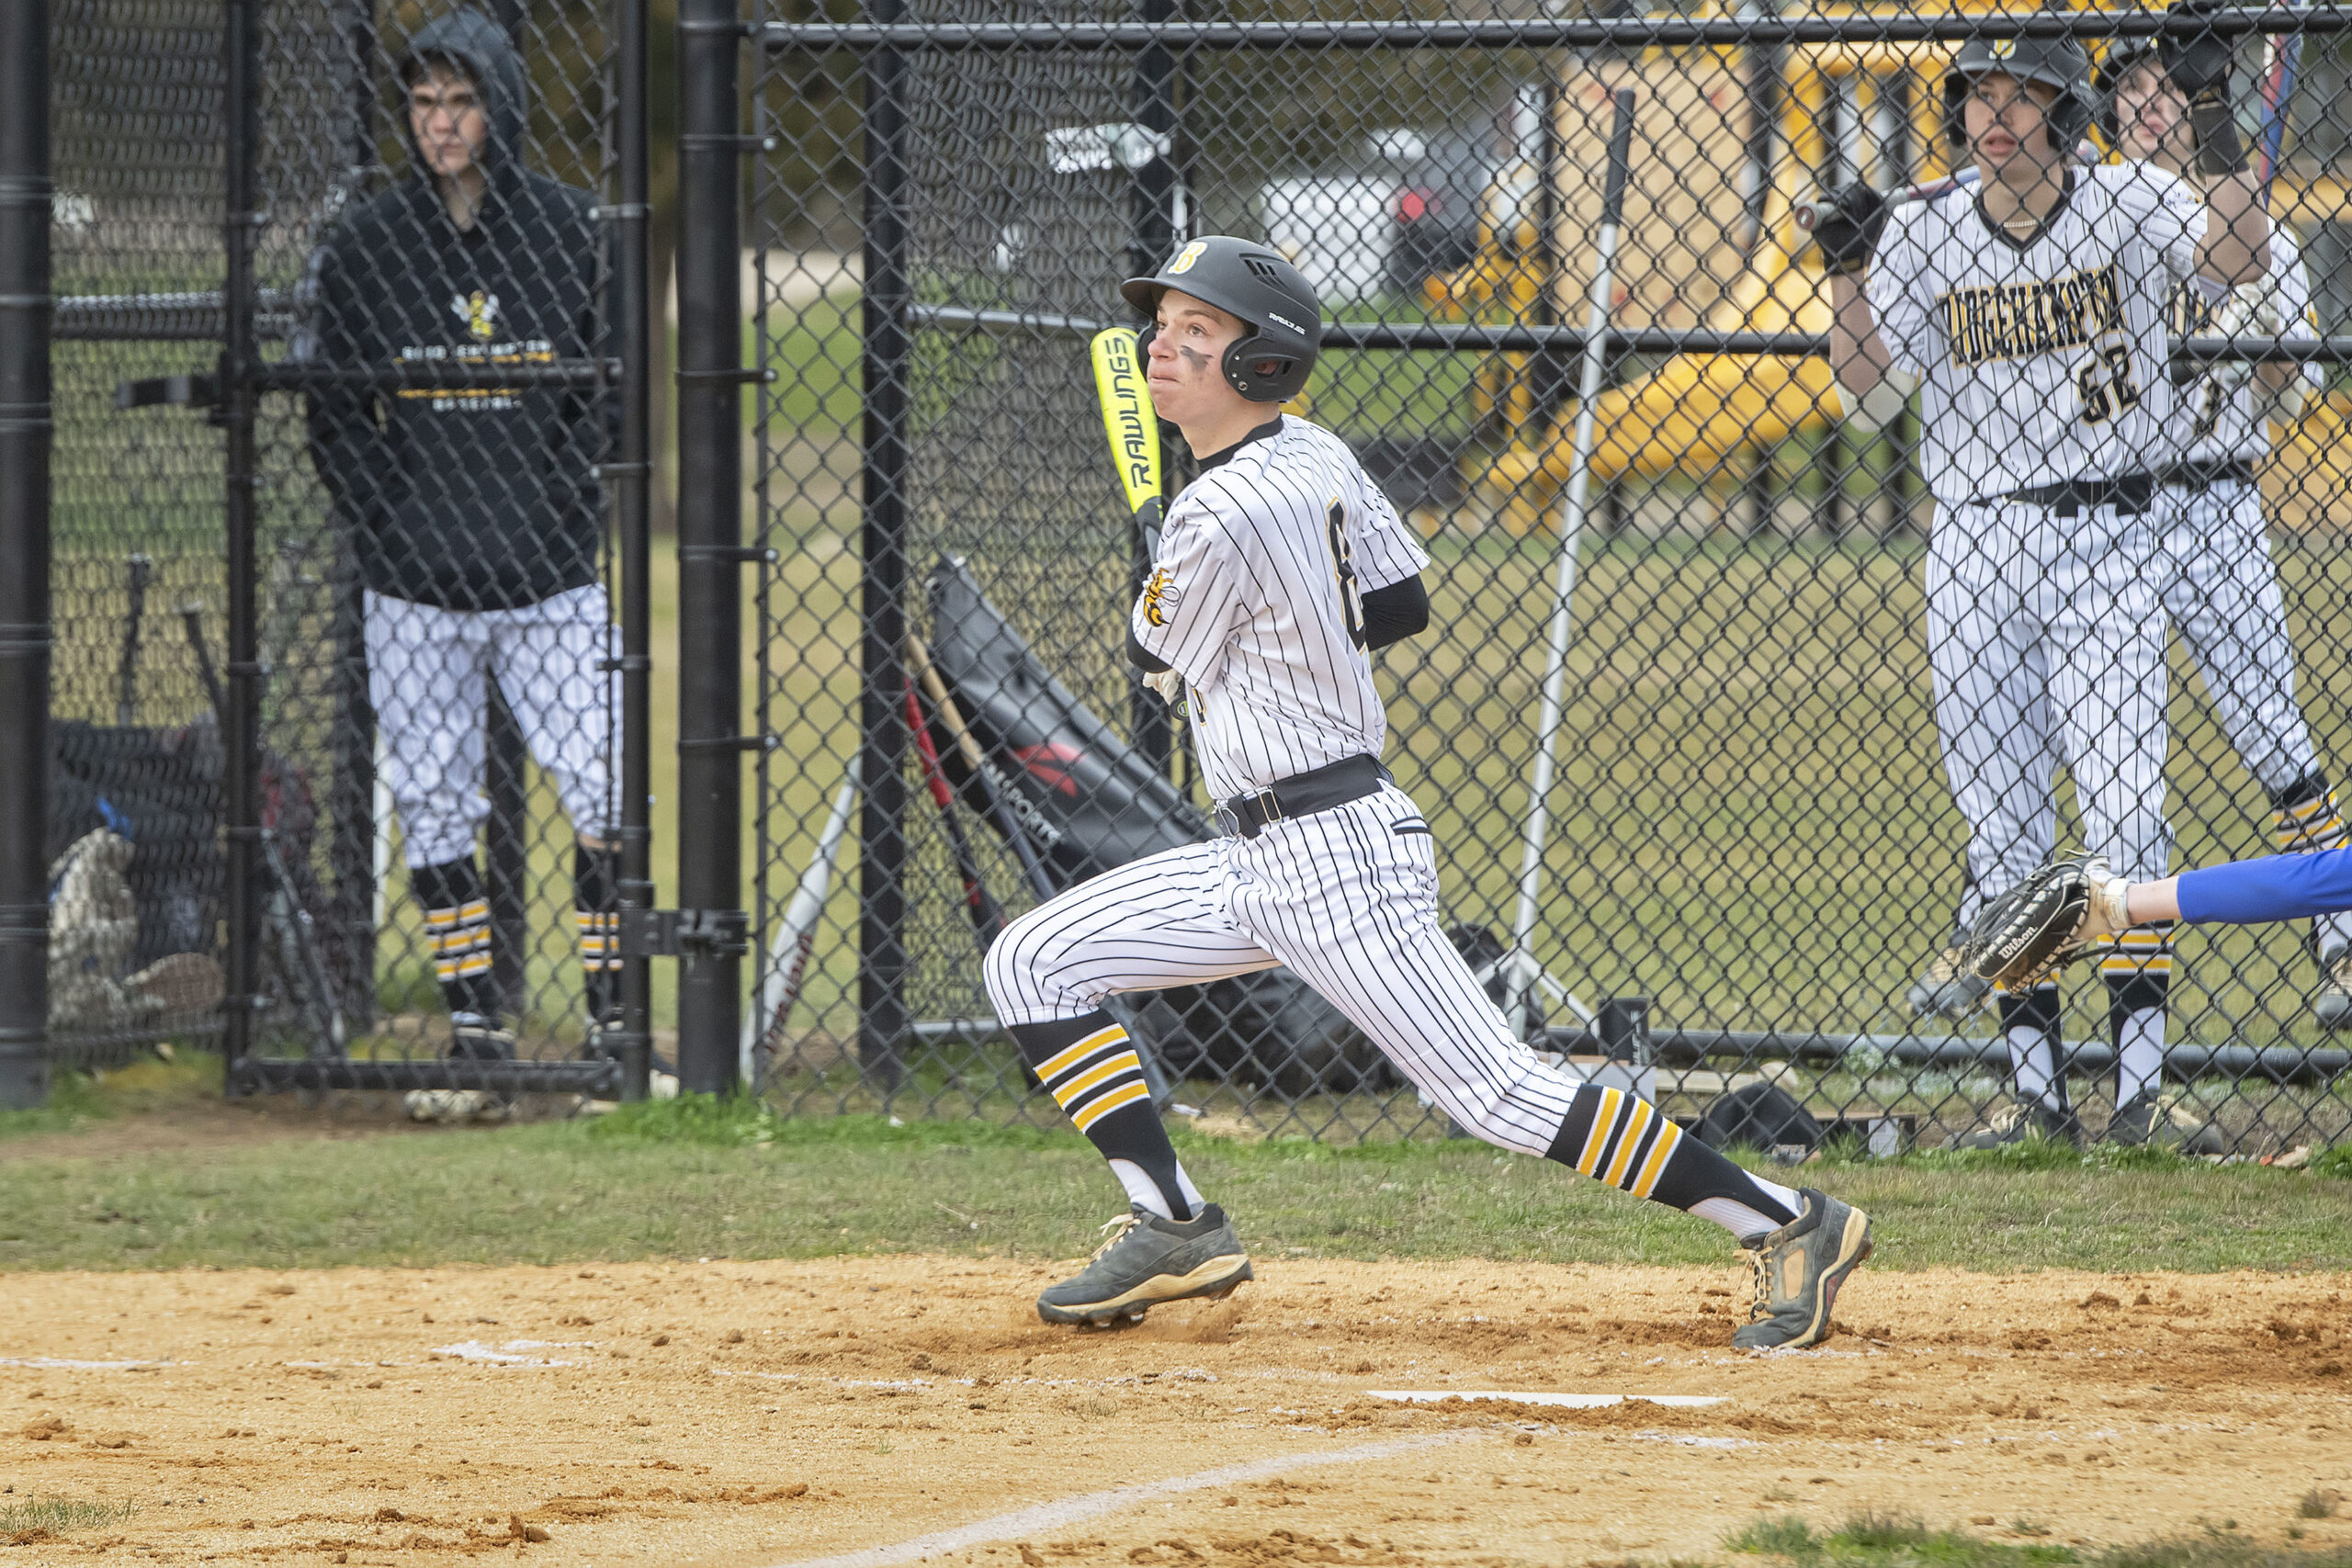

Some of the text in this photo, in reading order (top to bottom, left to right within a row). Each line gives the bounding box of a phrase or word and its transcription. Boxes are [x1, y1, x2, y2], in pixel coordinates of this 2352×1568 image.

[1167, 242, 1208, 274] B
[1105, 337, 1152, 489] RAWLINGS
[1997, 926, 2038, 959] Wilson
